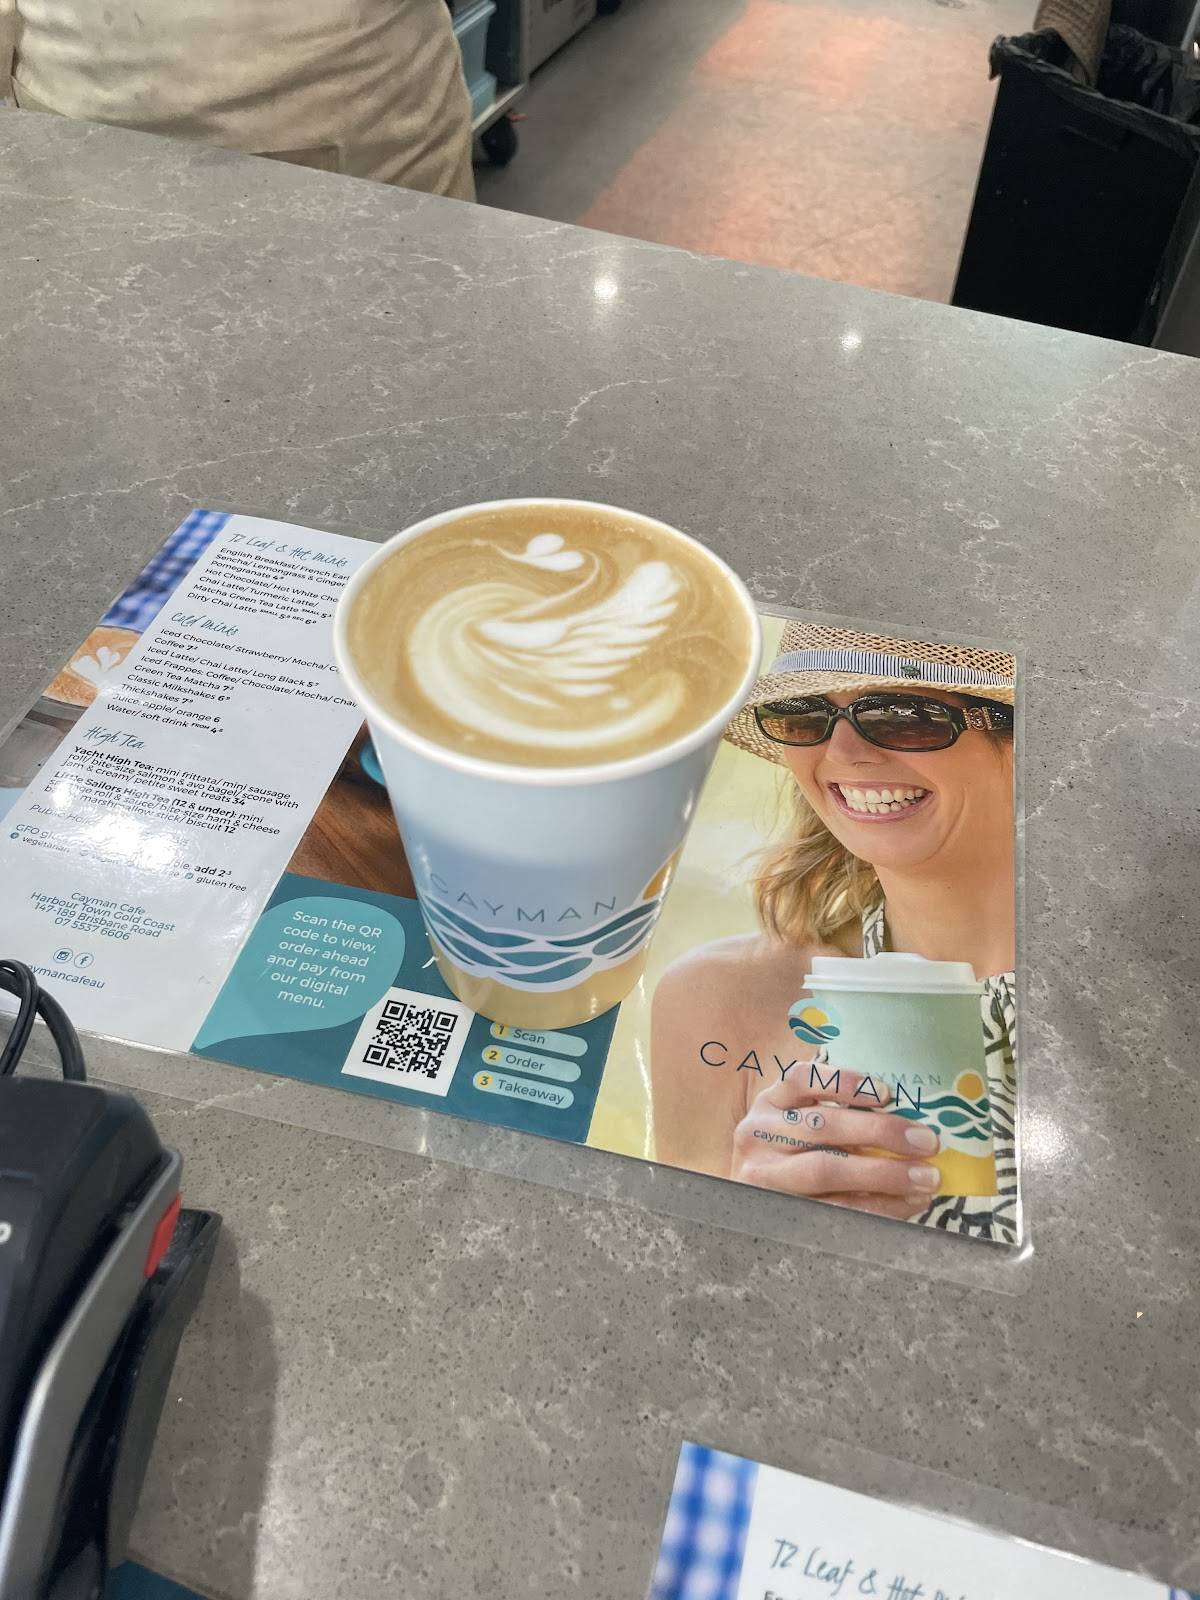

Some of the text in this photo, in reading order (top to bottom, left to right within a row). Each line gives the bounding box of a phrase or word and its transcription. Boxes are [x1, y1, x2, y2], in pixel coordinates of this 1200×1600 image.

[220, 547, 351, 581] English Breakfast/ French Earl
[246, 536, 276, 551] Leaf
[289, 547, 312, 561] Hot
[312, 552, 348, 567] Drinks
[210, 560, 271, 579] Pomegranate
[253, 562, 306, 579] Lemongrass
[315, 577, 346, 587] Ginger
[199, 576, 320, 608] Chai Latte/ Turmeric Latte/
[205, 568, 222, 576] Hot
[223, 572, 274, 589] Chocolate/
[273, 584, 290, 593] Hot
[292, 588, 319, 599] White
[187, 592, 211, 602] Dirty
[211, 598, 233, 608] Chai
[233, 603, 258, 613] Latte
[193, 584, 228, 597] Matcha
[229, 592, 257, 604] Green
[259, 599, 274, 608] Tea
[275, 603, 299, 613] Latte
[171, 612, 239, 636] Cold Drinks
[154, 637, 185, 648] Coffee
[160, 628, 183, 638] Iced
[183, 633, 236, 650] Chocolate/
[235, 646, 292, 663] Strawberry/
[292, 658, 329, 671] Mocha/
[134, 664, 164, 676] Green
[166, 671, 182, 681] Tea
[184, 676, 221, 690] Matcha
[140, 655, 163, 665] Iced
[206, 671, 242, 684] Coffee/
[241, 678, 295, 695] Chocolate/
[295, 689, 334, 702] Mocha/
[147, 646, 170, 656] Iced
[170, 651, 200, 663] Latte/
[199, 659, 223, 669] Chai
[223, 664, 254, 676] Latte/
[252, 670, 277, 681] Long
[278, 676, 306, 686] Black
[122, 683, 180, 703] Thickshakes
[127, 674, 161, 687] Classic
[162, 682, 216, 700] Milkshakes
[106, 703, 141, 717] Water/
[140, 712, 161, 721] soft
[161, 717, 189, 728] drink
[142, 700, 178, 714] apple/
[176, 709, 212, 722] orange
[83, 726, 145, 749] High Tea
[74, 745, 291, 800] Yacht High Tea: mini frittata/ mini sausage
[91, 756, 135, 774] bite-size
[136, 769, 176, 784] salmon
[186, 780, 205, 790] avo
[207, 784, 243, 797] bagel/
[242, 793, 273, 804] scone
[275, 799, 300, 809] with
[84, 778, 122, 793] Sailors
[123, 787, 150, 800] High
[152, 794, 170, 804] Tea
[188, 802, 196, 810] &
[239, 813, 264, 823] mini
[95, 768, 135, 782] cream/
[133, 777, 166, 789] petite
[166, 784, 199, 797] sweet
[200, 790, 231, 803] treats
[231, 797, 246, 806] 34
[29, 804, 66, 818] Pubc
[80, 794, 154, 817] marshallow
[185, 817, 222, 831] biscuit
[224, 825, 236, 834] 12
[159, 803, 205, 819] bite-size
[205, 813, 231, 825] ham
[242, 822, 281, 835] cheese
[15, 823, 40, 835] GFO
[193, 865, 217, 876] add
[195, 875, 247, 892] gluten free
[30, 891, 176, 932] Harbour Town Gold Coast
[71, 892, 146, 915] Cayman Cafe
[430, 873, 617, 923] CAYMAN
[34, 902, 162, 938] 147-189 Brisbane Road
[54, 917, 131, 941] 07 5537 6606
[292, 910, 383, 938] Scan the QR
[283, 926, 320, 941] code
[322, 932, 338, 944] to
[279, 940, 369, 968] order ahead
[27, 963, 105, 989] ymancafeau
[266, 954, 366, 984] and pay from
[271, 972, 349, 996] our digital
[277, 990, 325, 1009] menu.
[498, 1025, 546, 1045] 1 Scan
[488, 1050, 546, 1071] 2 Order
[700, 1041, 921, 1112] CAYMAN
[480, 1076, 565, 1105] 3 Takeaway
[770, 1538, 799, 1569] T2
[803, 1547, 855, 1597] Leaf
[858, 1568, 877, 1595] &
